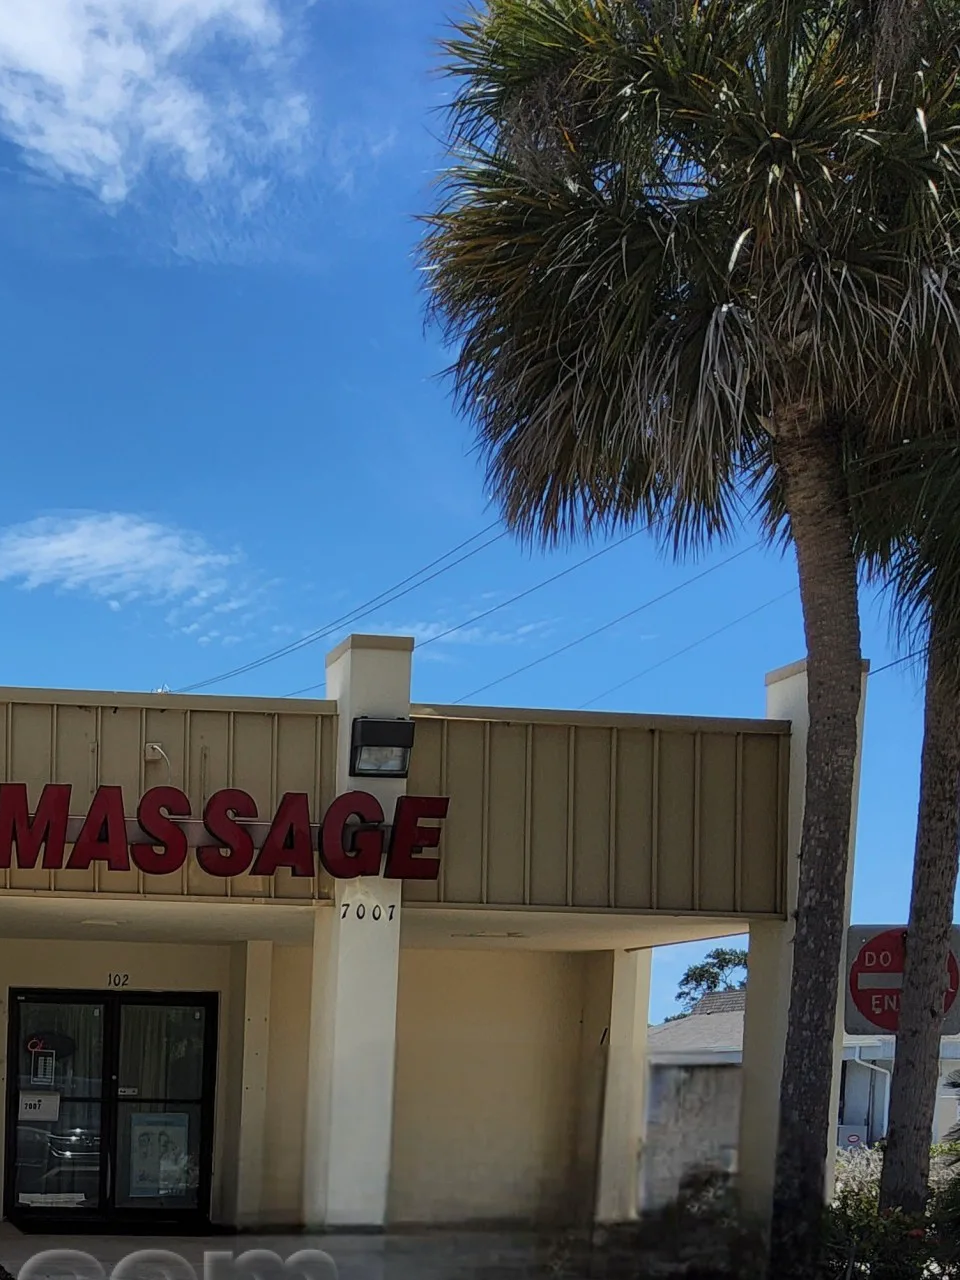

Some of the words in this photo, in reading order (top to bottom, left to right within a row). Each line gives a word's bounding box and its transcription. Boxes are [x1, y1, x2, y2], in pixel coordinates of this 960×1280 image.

[341, 903, 396, 922] 7007
[865, 951, 892, 967] DO
[108, 973, 129, 987] 102
